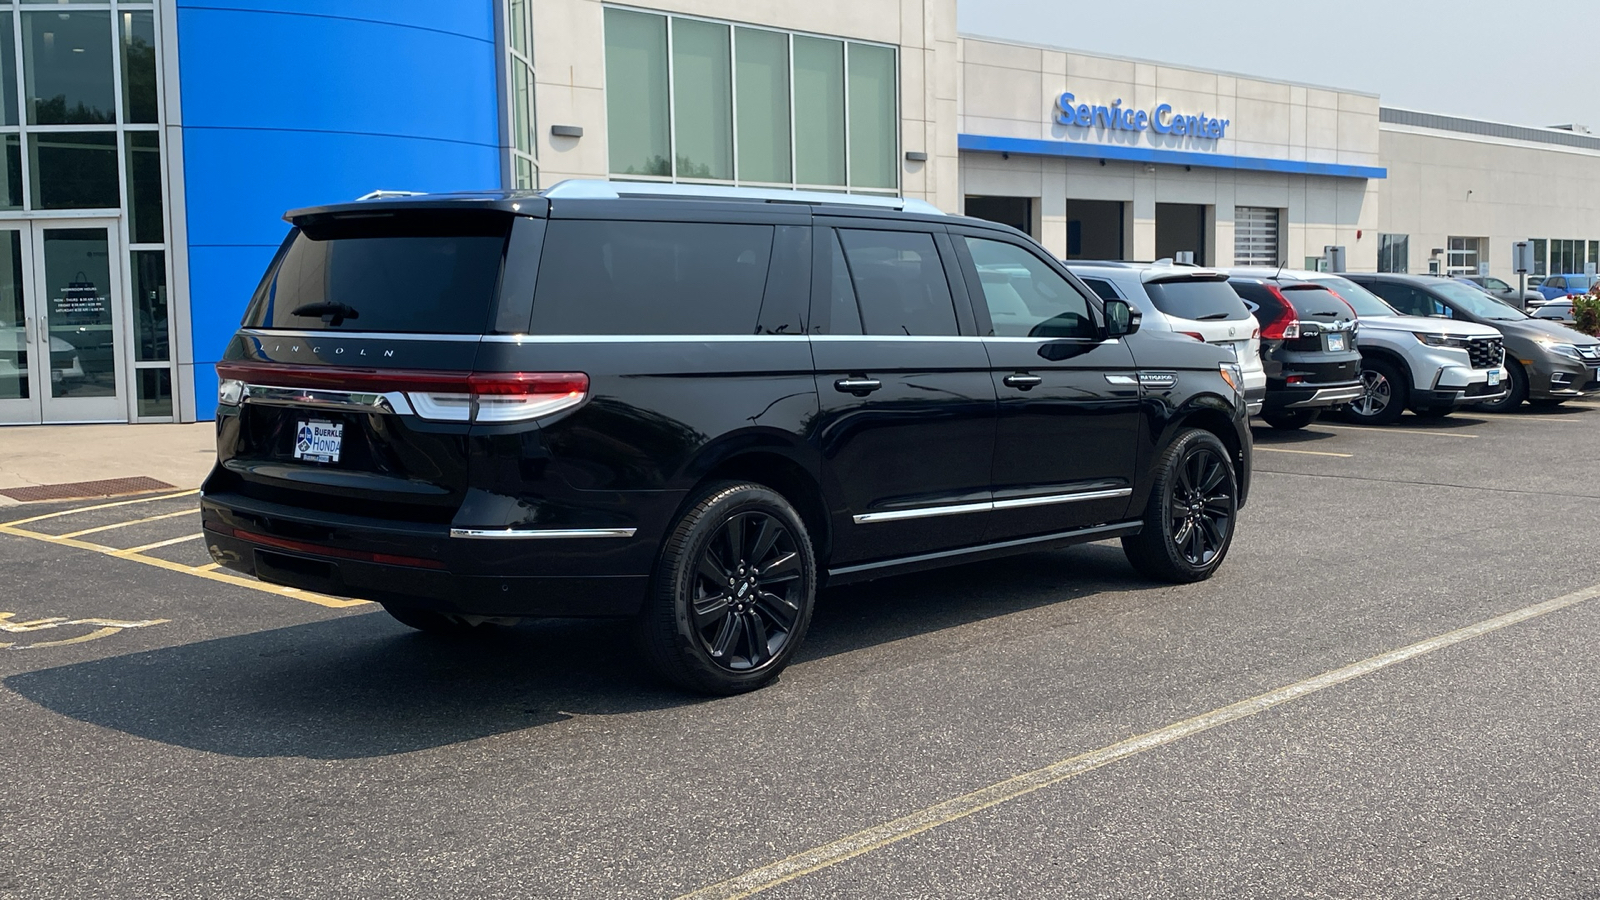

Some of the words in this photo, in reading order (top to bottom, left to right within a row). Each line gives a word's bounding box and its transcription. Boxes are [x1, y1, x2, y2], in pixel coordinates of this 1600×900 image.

[1057, 92, 1148, 132] Service
[1152, 104, 1230, 139] Center
[260, 345, 393, 357] LINCOLN
[314, 426, 342, 438] BUERKLE
[313, 437, 340, 452] HONDA
